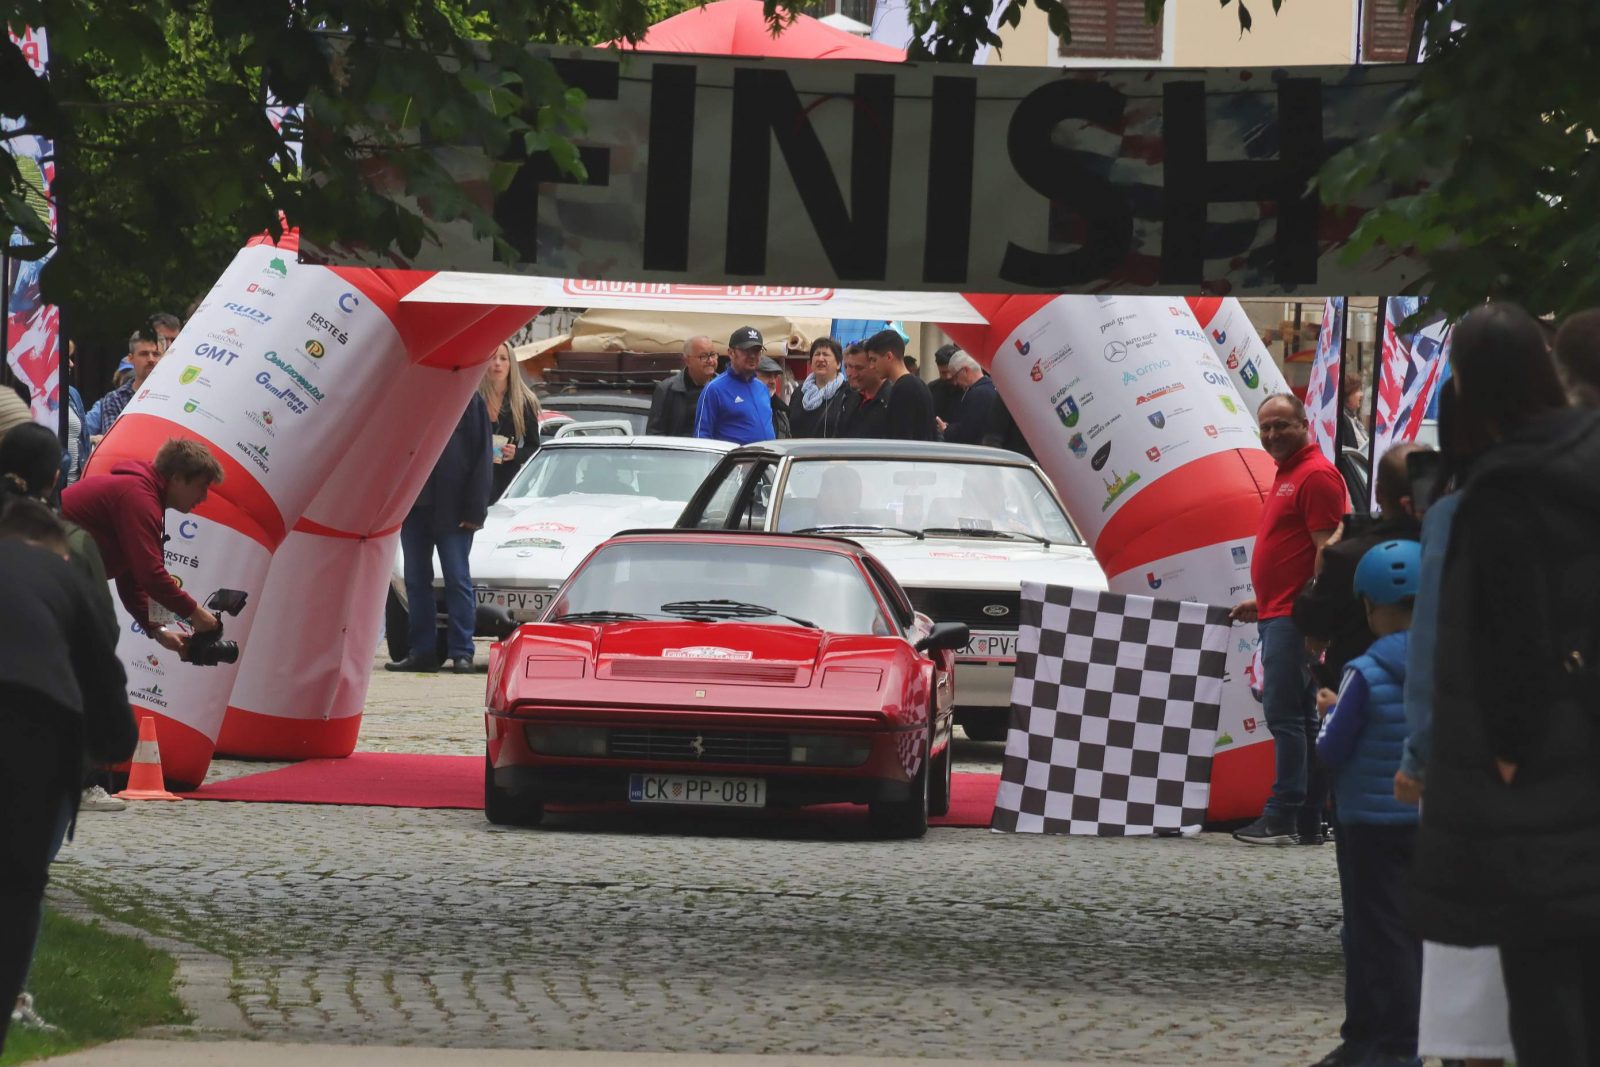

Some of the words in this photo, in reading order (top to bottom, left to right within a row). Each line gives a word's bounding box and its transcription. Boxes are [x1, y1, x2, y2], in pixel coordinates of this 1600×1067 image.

[494, 57, 1324, 286] FINISH
[223, 302, 272, 322] RUDI
[310, 312, 340, 338] ERSTE
[1125, 336, 1142, 347] AUTO
[195, 343, 239, 366] GMT
[645, 778, 669, 800] CK
[686, 780, 759, 803] PP-081
